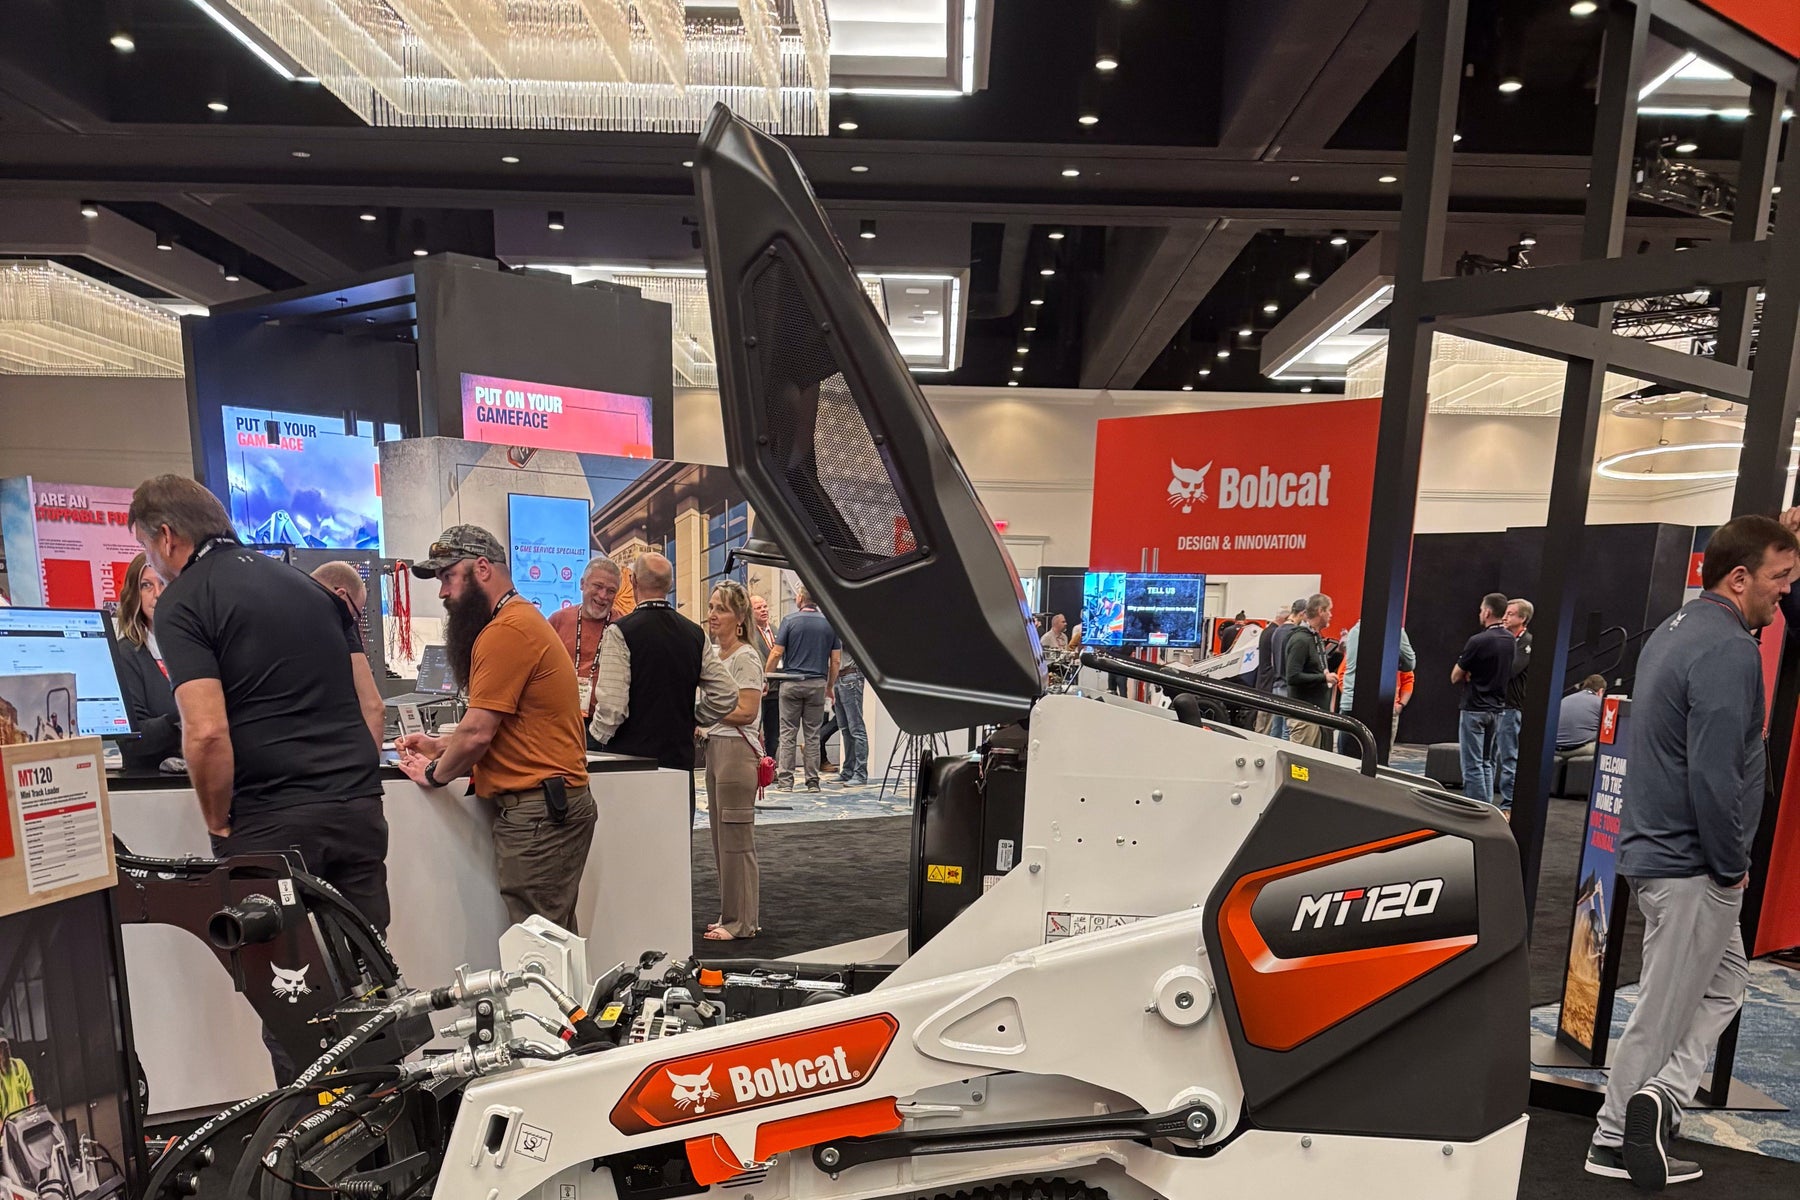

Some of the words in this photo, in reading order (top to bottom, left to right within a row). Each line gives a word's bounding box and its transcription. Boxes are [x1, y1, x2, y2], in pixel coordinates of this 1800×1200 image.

[475, 386, 502, 405] PUT
[505, 389, 525, 409] ON
[527, 394, 563, 414] YOUR
[236, 416, 260, 432] PUT
[283, 421, 317, 438] YOUR
[477, 405, 549, 429] GAMEFACE
[237, 431, 304, 452] GAMACE
[1218, 464, 1332, 509] Bobcat
[40, 493, 67, 507] ARE
[68, 494, 88, 509] AN
[1178, 536, 1219, 550] DESIGN
[1222, 535, 1231, 550] &
[1234, 534, 1307, 550] INNOVATION
[1600, 754, 1627, 776] WELCOM
[17, 766, 53, 787] MT120
[20, 790, 31, 799] Mini
[31, 788, 44, 798] Track
[45, 786, 60, 796] Loader
[1291, 879, 1444, 932] MT120
[728, 1046, 852, 1103] Bobcat
